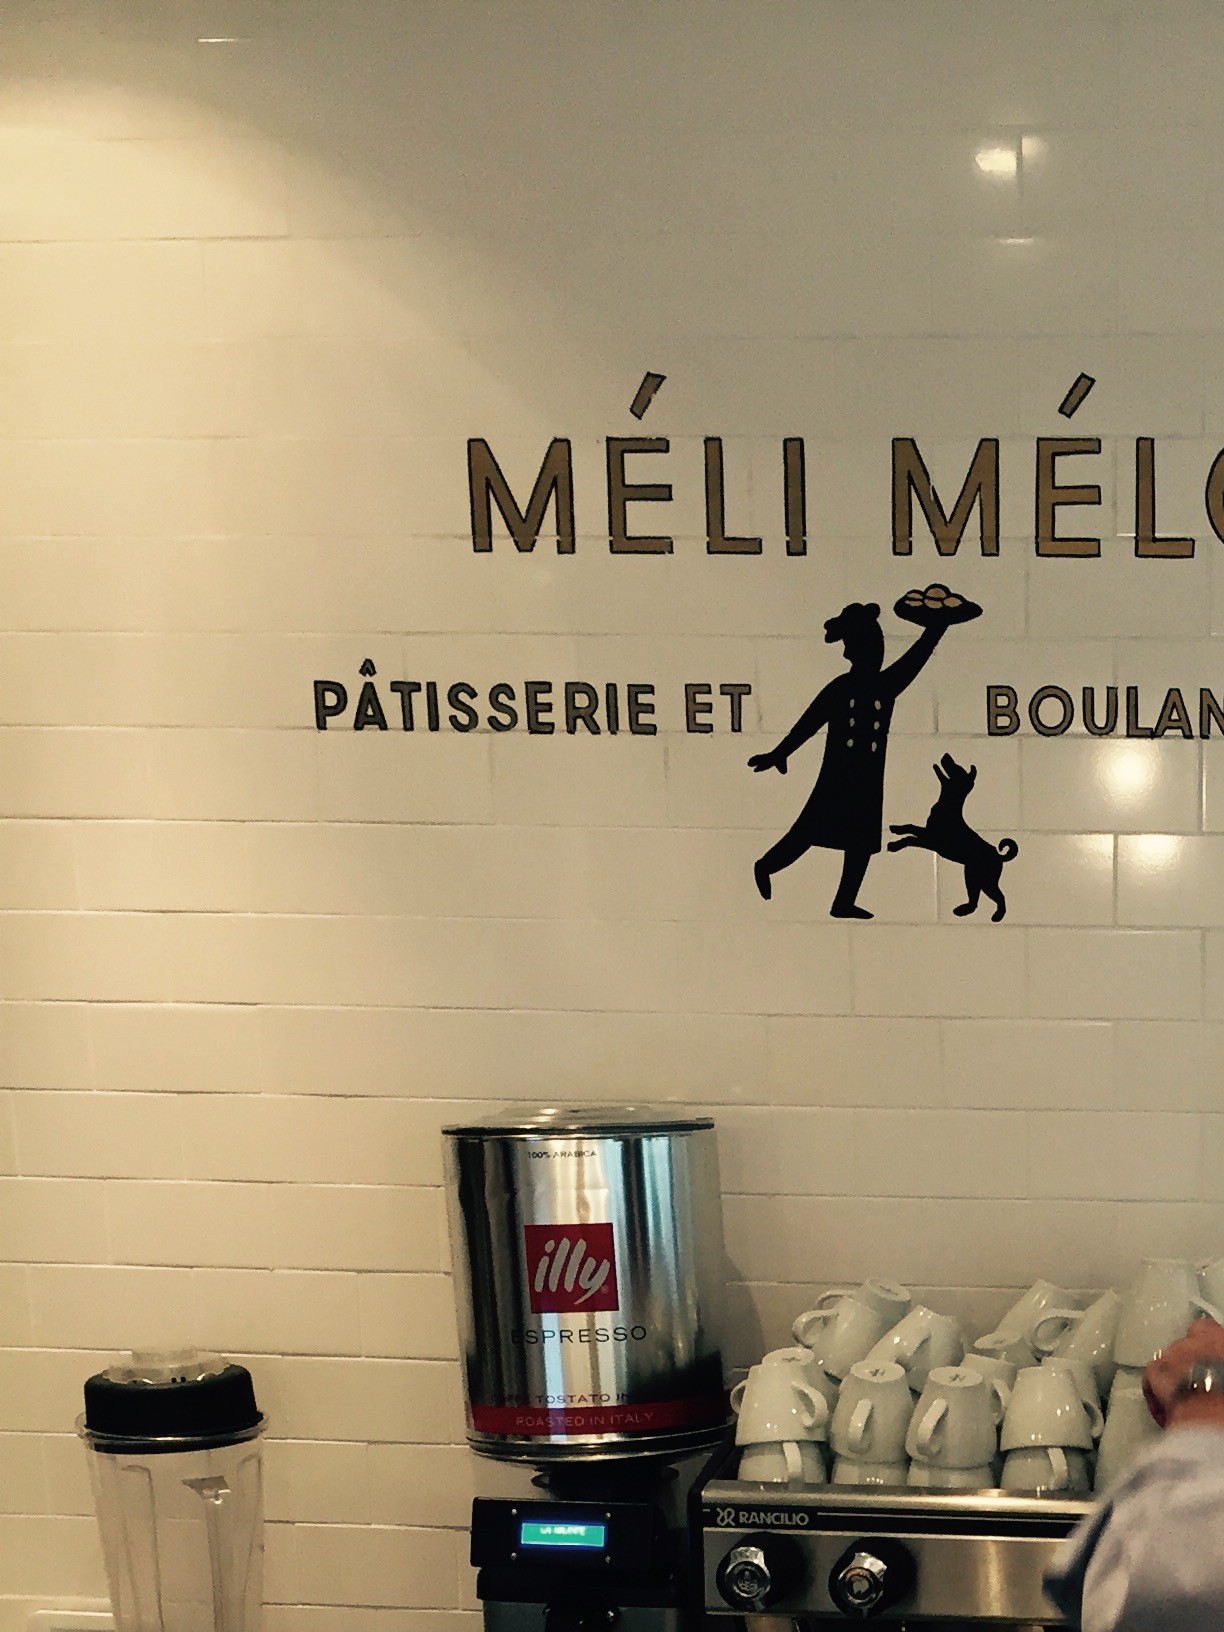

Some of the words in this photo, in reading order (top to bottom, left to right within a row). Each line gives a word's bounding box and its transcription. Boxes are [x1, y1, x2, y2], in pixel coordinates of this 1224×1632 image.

[467, 372, 807, 556] MÉLI
[313, 657, 657, 735] PÂTISSERIE
[685, 682, 752, 734] ET
[553, 1149, 597, 1159] ARABICA
[534, 1236, 611, 1305] illy
[510, 1325, 647, 1345] ESPRESSO
[535, 1393, 611, 1405] TOSTATO
[515, 1415, 585, 1428] ROASTED
[589, 1415, 605, 1427] IN
[609, 1411, 656, 1426] ITALY
[739, 1510, 810, 1527] RANCILIO
